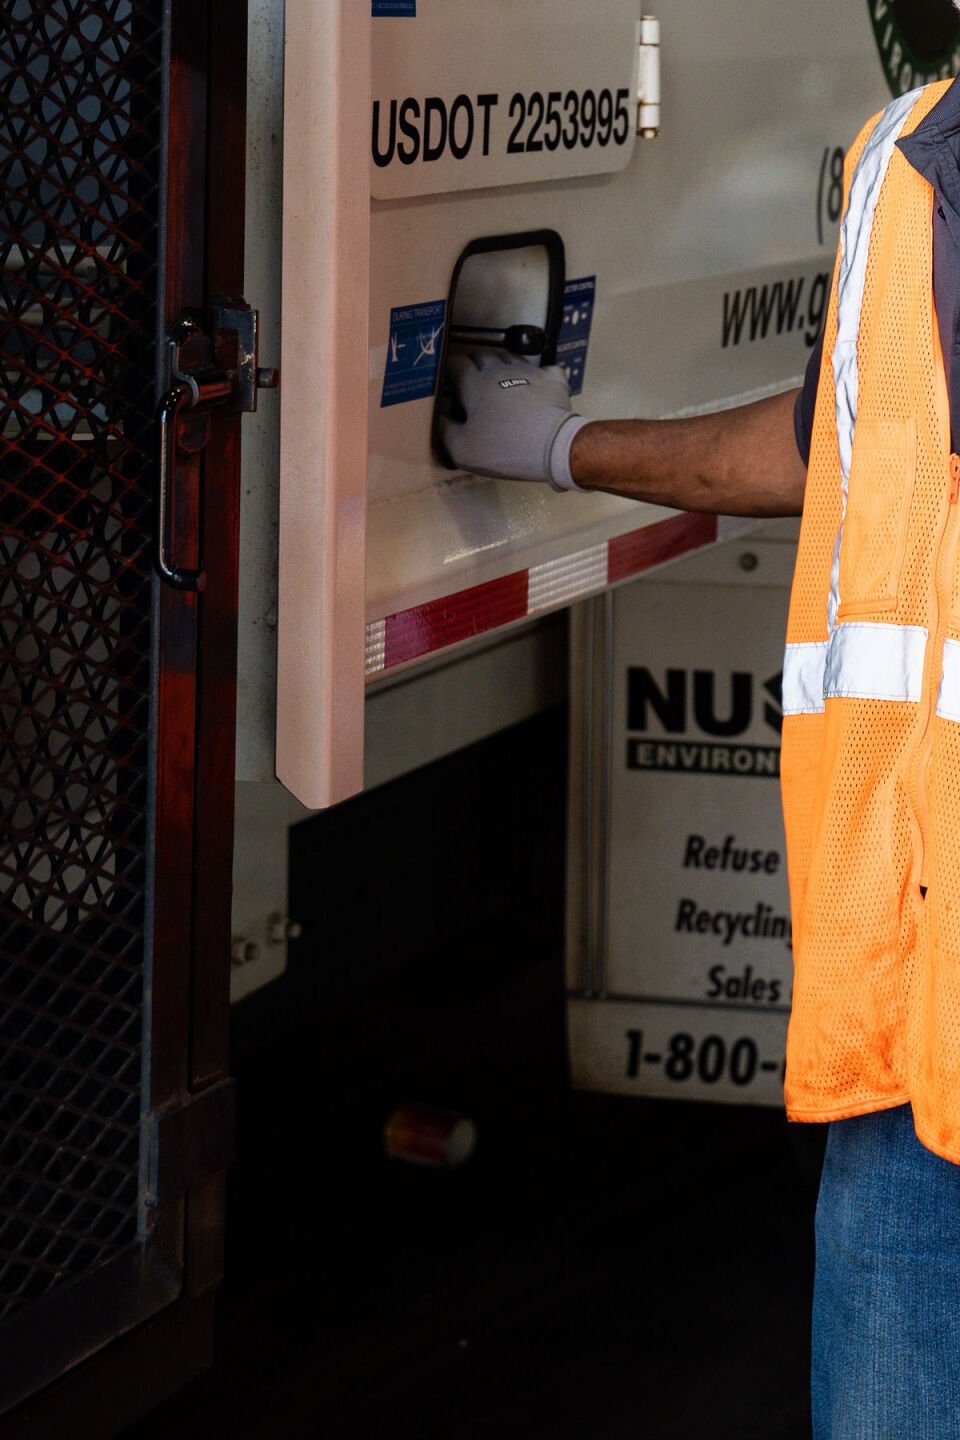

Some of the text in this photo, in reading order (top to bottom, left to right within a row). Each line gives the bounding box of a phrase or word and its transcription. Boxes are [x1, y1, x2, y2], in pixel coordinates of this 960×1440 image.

[371, 88, 629, 168] USDOT 2253995
[682, 834, 781, 874] Refuse
[706, 963, 782, 1003] Sales
[624, 1028, 786, 1087] 1-800-
